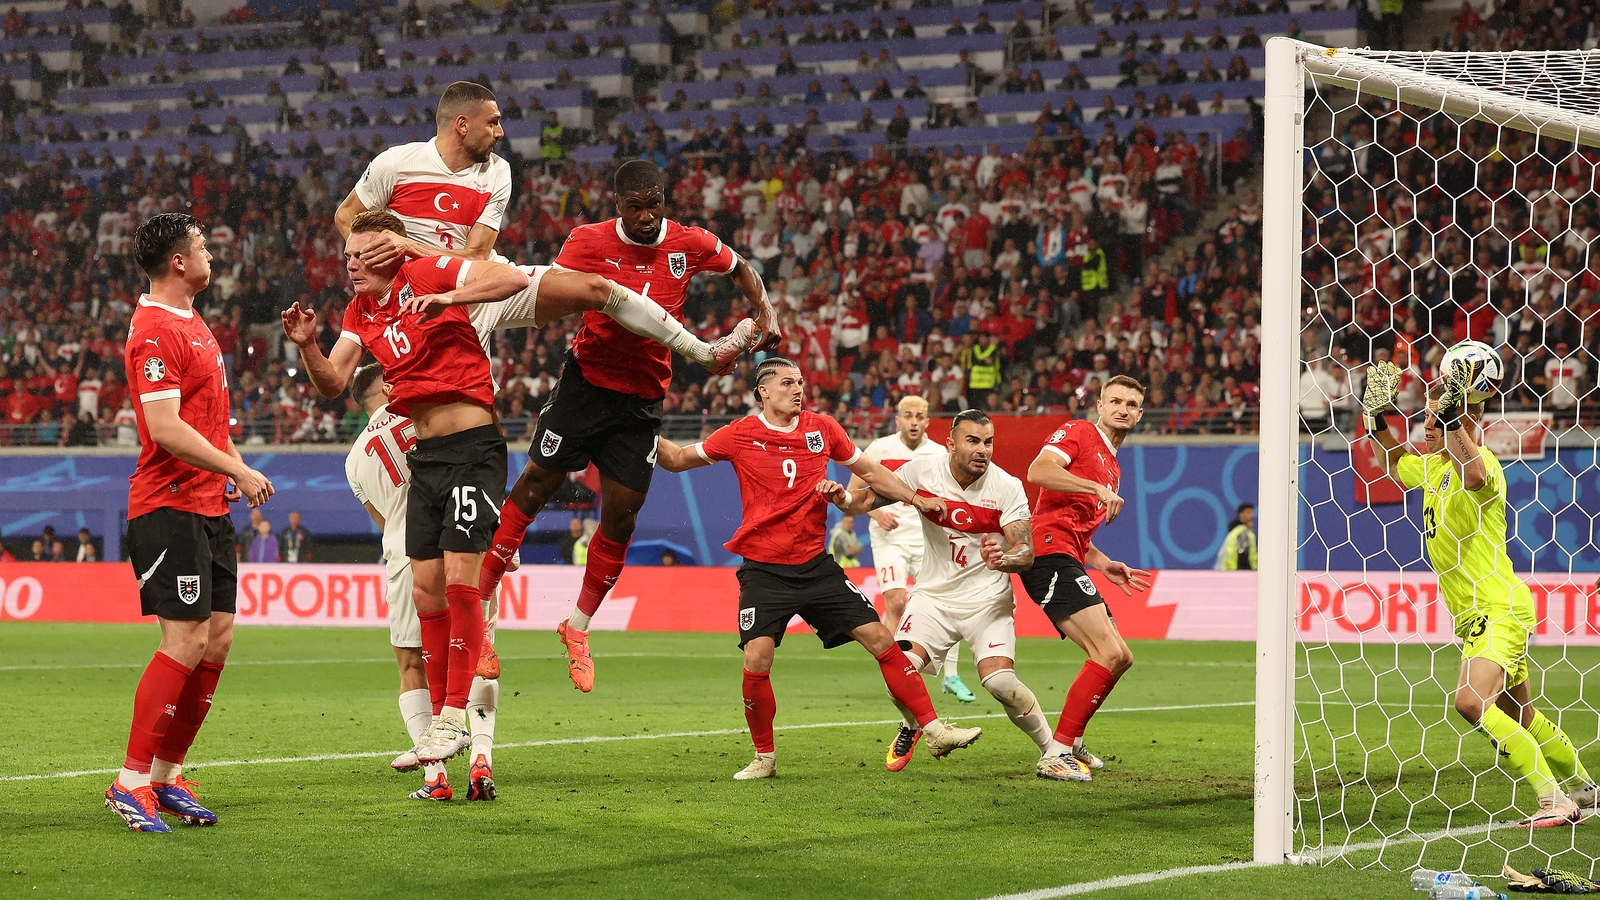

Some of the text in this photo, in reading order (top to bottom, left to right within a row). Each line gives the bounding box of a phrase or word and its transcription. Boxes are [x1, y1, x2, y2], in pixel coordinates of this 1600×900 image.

[383, 319, 411, 359] 15
[646, 434, 658, 469] 4
[782, 458, 797, 489] 9
[452, 485, 478, 522] 15
[950, 541, 968, 569] 14
[881, 565, 895, 584] 21
